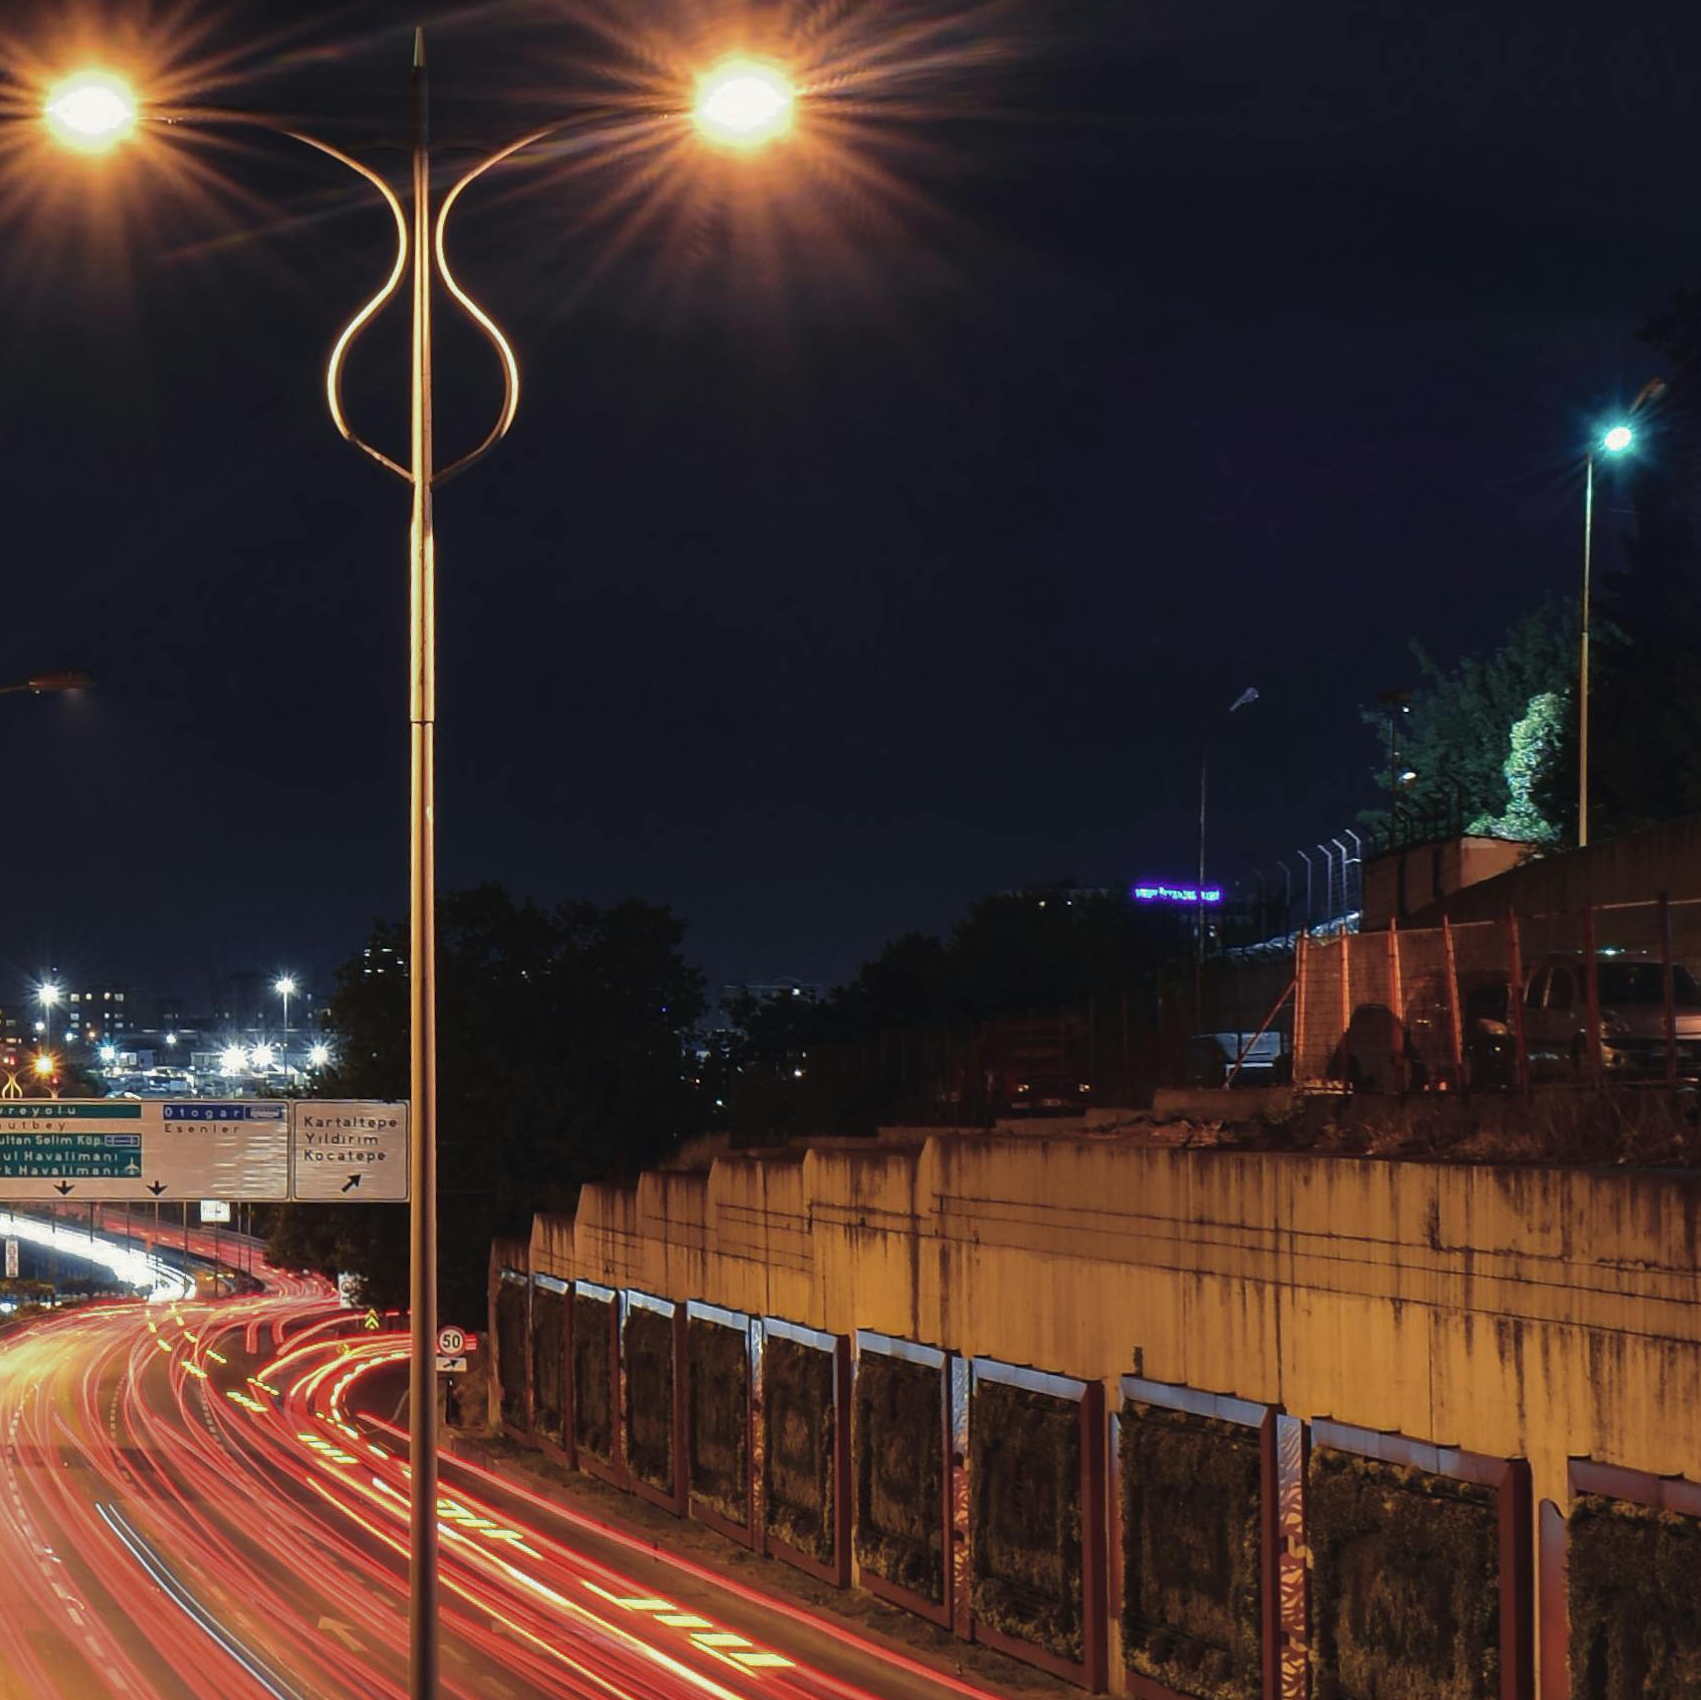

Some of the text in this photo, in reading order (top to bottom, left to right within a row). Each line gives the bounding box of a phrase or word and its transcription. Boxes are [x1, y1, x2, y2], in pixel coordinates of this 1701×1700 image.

[164, 1106, 241, 1119] Otogar
[164, 1123, 240, 1133] Esenler
[304, 1115, 398, 1130] Kartaltepe
[35, 1135, 73, 1145] Selim
[77, 1134, 104, 1147] Köp.
[305, 1133, 378, 1145] Yıldırım
[24, 1151, 119, 1161] Havalimanı
[304, 1149, 386, 1163] Kocatepe
[18, 1165, 119, 1176] Havalimanı
[443, 1335, 460, 1348] 50
